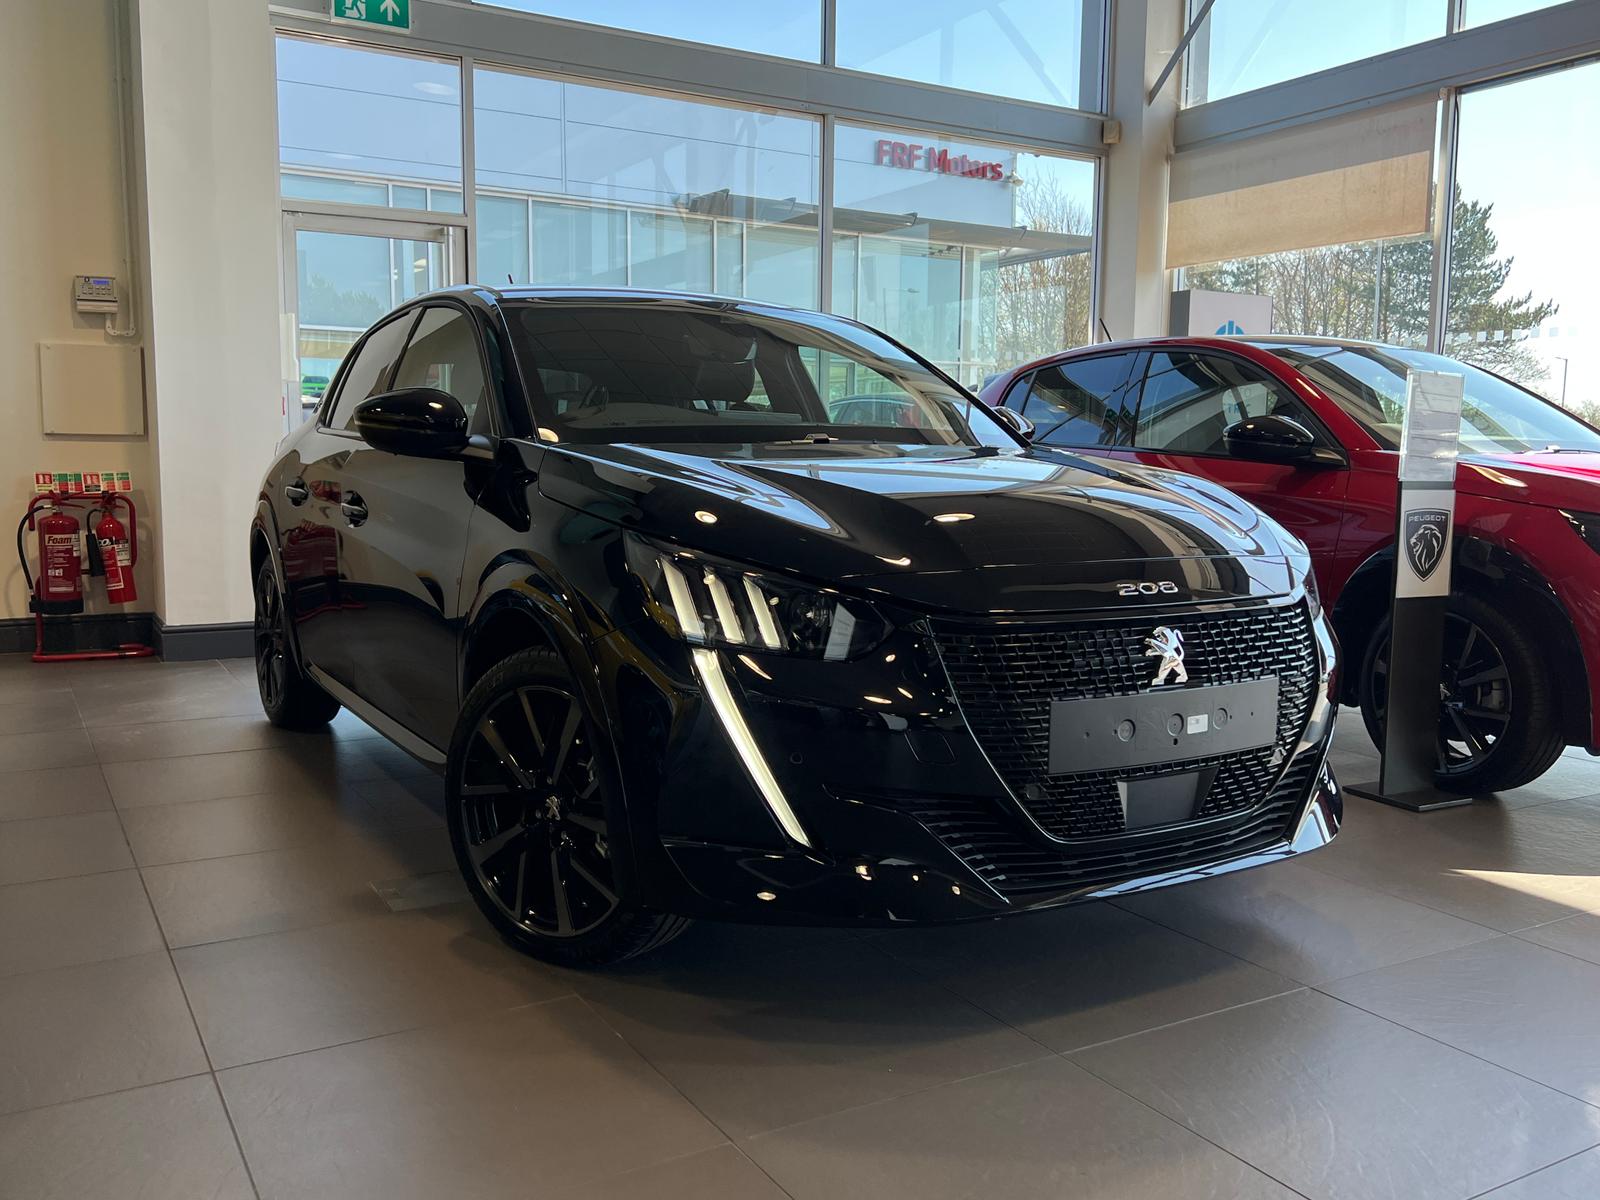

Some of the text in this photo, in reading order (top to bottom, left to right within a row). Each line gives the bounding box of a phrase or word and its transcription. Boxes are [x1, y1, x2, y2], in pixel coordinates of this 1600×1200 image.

[876, 139, 1003, 181] FRF Motors
[1408, 514, 1446, 522] PEUGEOT
[47, 535, 72, 544] Foam
[1116, 581, 1179, 596] 208
